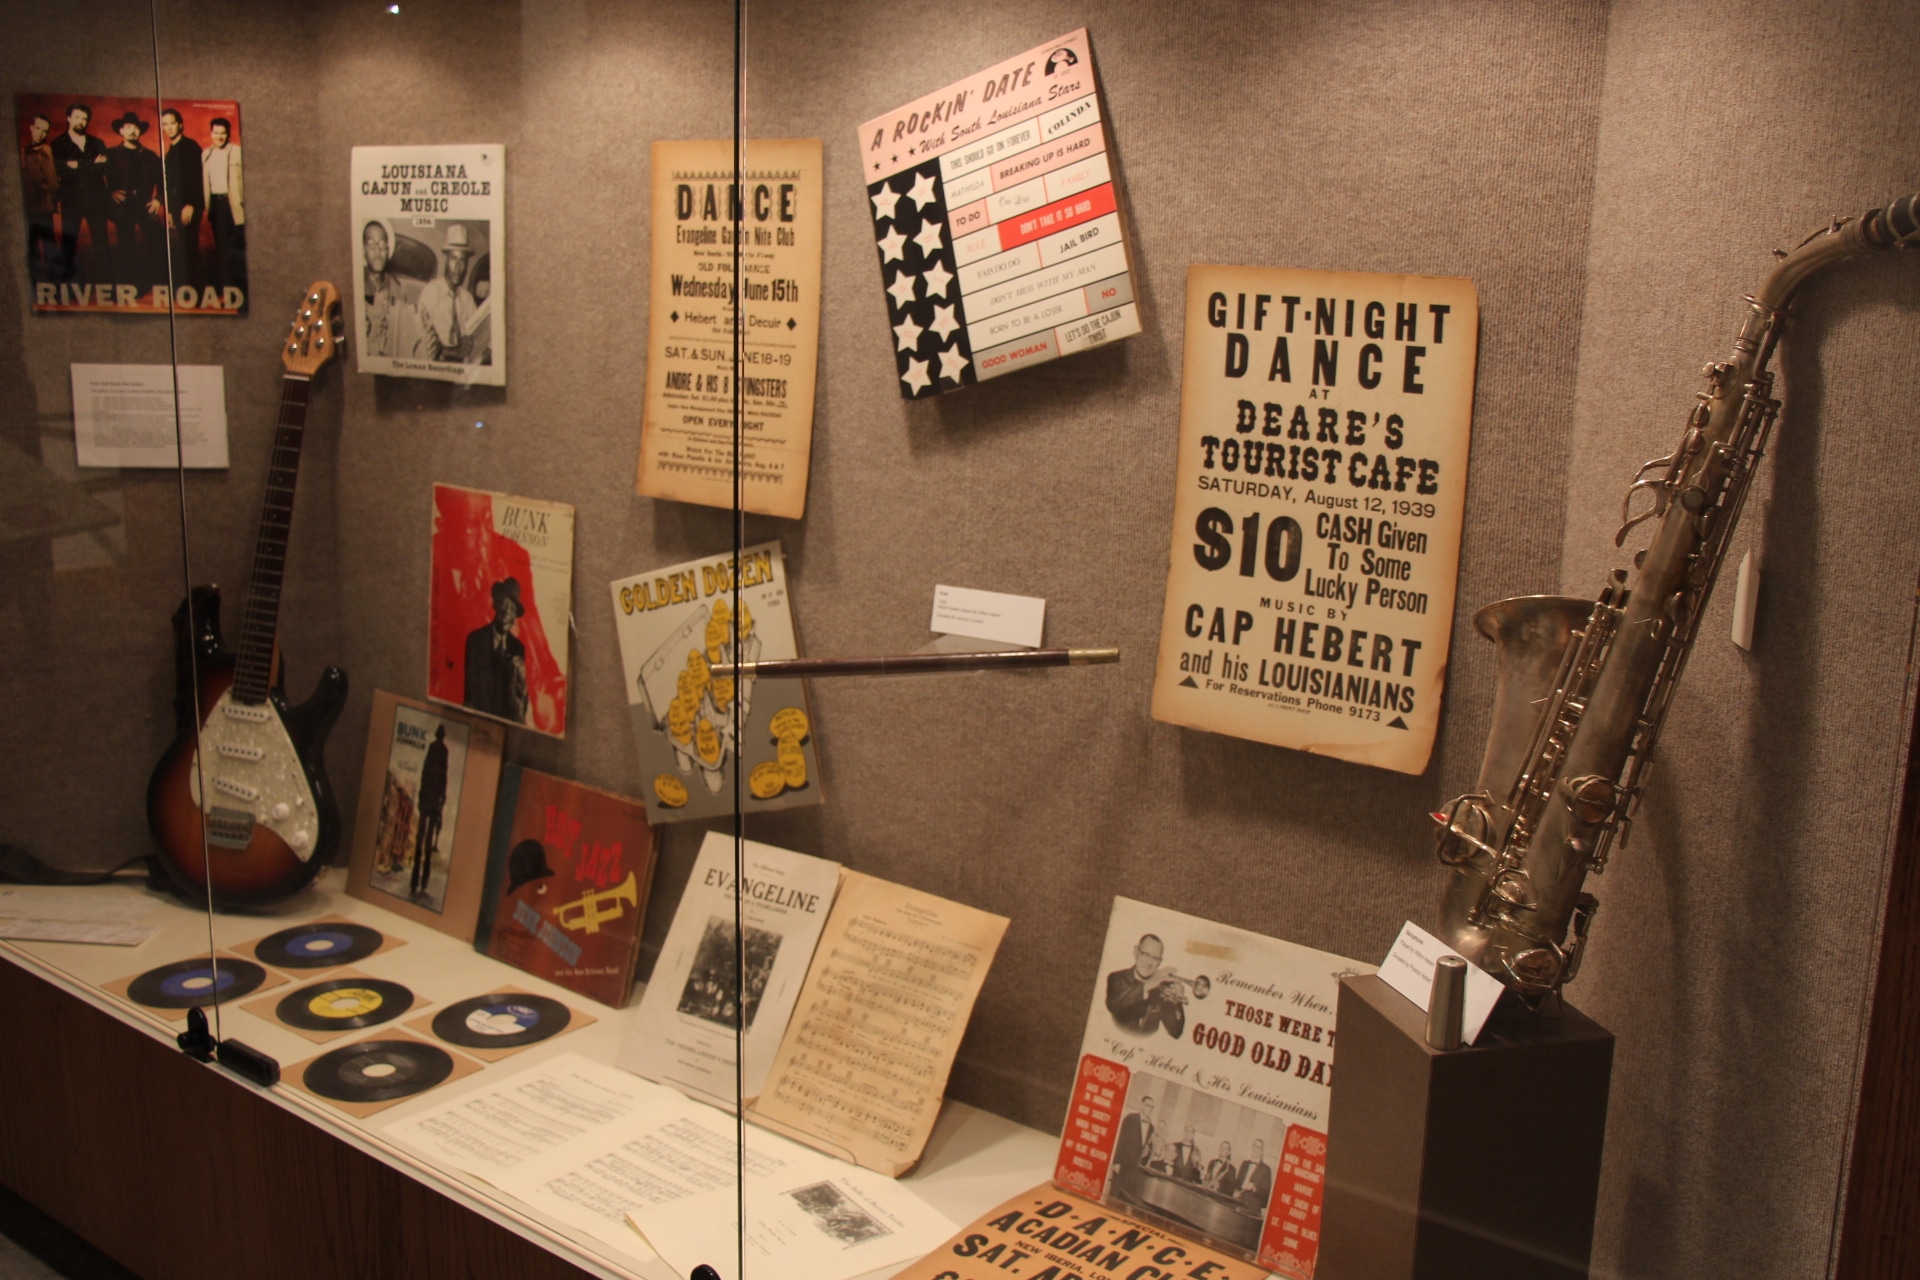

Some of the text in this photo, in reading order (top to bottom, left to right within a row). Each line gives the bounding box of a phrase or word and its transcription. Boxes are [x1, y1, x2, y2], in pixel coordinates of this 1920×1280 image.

[871, 61, 1036, 151] A ROCKIN' DATE
[919, 81, 1081, 154] With South Louisiana Stars
[1048, 102, 1092, 134] COLINDA
[950, 130, 1031, 171] THIS SHOULD GO ON FOREVER
[999, 138, 1091, 180] BREAKING UP IS HARD
[382, 164, 468, 179] LOUISIANA
[1061, 170, 1092, 187] FAMILY
[361, 181, 412, 196] CAJUN
[430, 181, 491, 196] CREOLE
[677, 183, 795, 223] DANCE
[951, 182, 985, 199] MATHILDA
[399, 198, 449, 213] MUSIC
[956, 211, 980, 227] TO DO
[1039, 214, 1055, 229] TAKE
[1056, 211, 1063, 221] IT
[1064, 207, 1074, 219] SO
[1074, 201, 1092, 215] HARD
[677, 225, 718, 247] Evangeline
[754, 226, 771, 246] Nite
[776, 226, 795, 247] Club
[1060, 226, 1099, 254] JAIL BIRD
[698, 262, 714, 273] OLD
[994, 262, 1007, 272] DO
[1008, 257, 1020, 269] DO
[1037, 276, 1060, 290] WITH
[1061, 269, 1075, 283] MY
[1077, 263, 1097, 278] MAN
[37, 282, 245, 310] RIVER ROAD
[671, 274, 799, 306] Wednesday June 15th
[1101, 287, 1117, 300] NO
[684, 311, 717, 325] Hebert
[748, 314, 782, 329] Decuir
[989, 305, 1063, 337] BORN TO BE A LOSER
[1064, 309, 1121, 343] LET'S DO THE CAJUN
[1087, 329, 1108, 346] TWIST
[428, 363, 466, 376] Recordings
[760, 352, 792, 366] 18-19
[981, 342, 1048, 369] GOOD WOMAN
[1224, 332, 1426, 395] DANCE
[666, 371, 788, 399] ANDRE & HIS 8 INGSTERS
[1308, 388, 1330, 400] AT
[682, 415, 704, 427] OPEN
[708, 417, 735, 430] EVERY
[1236, 399, 1404, 451] DEARE'S
[1201, 435, 1440, 496] TOURIST CAFE
[1197, 474, 1436, 519] SATURDAY, August 12, 1939
[503, 506, 552, 534] BUNK
[1316, 512, 1428, 554] CASH Given
[1193, 506, 1303, 583] $10
[1327, 542, 1412, 581] To Some
[620, 550, 774, 615] GOLDEN DOZEN
[1304, 568, 1428, 615] Lucky Person
[1259, 597, 1349, 622] MUSIC BY
[1184, 603, 1422, 678] CAP HEBERT
[1179, 649, 1415, 715] and his LOUISIANIANS
[1205, 678, 1381, 723] For Reservations Phone 9173
[397, 721, 428, 742] BUNK
[575, 842, 624, 888] JAZZ
[704, 868, 819, 914] EVANGELINE
[1215, 969, 1284, 999] Remember
[1225, 999, 1273, 1028] THOSE
[1279, 1015, 1321, 1042] WERE
[1192, 1021, 1247, 1057] GOOD
[1251, 1041, 1291, 1073] OLD
[1144, 1054, 1187, 1077] Hebert
[1193, 1069, 1209, 1089] &
[1207, 1073, 1232, 1092] His
[1238, 1082, 1318, 1121] Louisianians
[986, 1210, 1130, 1271] ACADIAN
[1120, 1218, 1167, 1241] SPECIAL
[952, 1233, 1020, 1274] SAT.
[1015, 1240, 1042, 1255] NEW
[1044, 1253, 1084, 1274] IBERIA,
